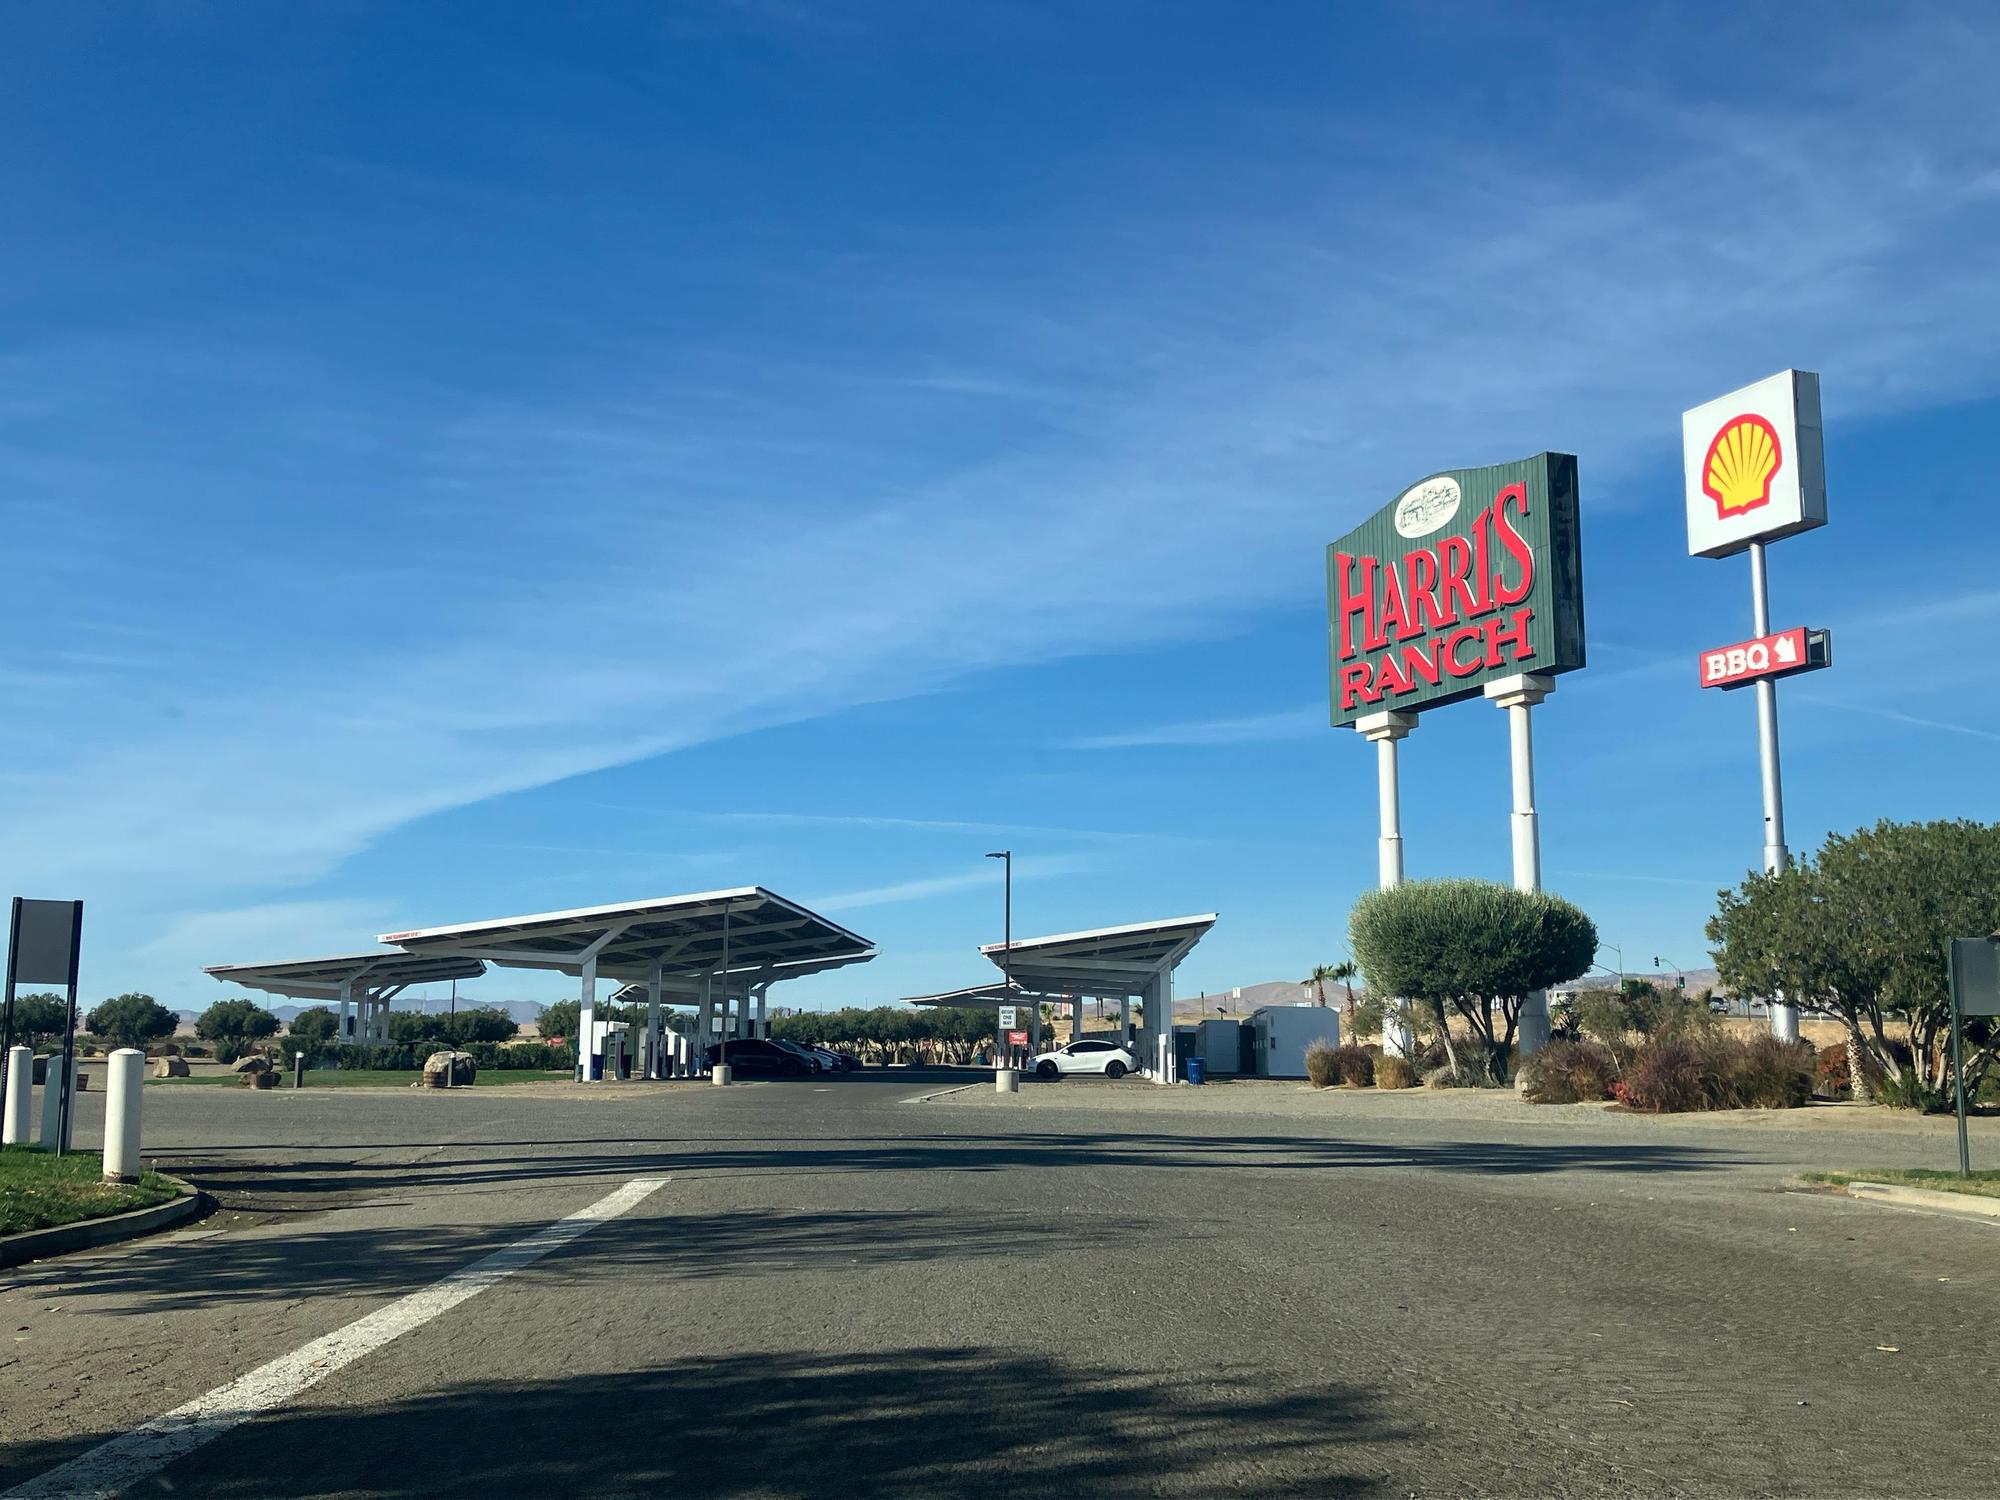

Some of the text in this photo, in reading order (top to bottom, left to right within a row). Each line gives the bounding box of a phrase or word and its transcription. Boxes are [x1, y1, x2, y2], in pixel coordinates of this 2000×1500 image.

[1335, 481, 1534, 660] HARRIS
[1339, 607, 1535, 710] RANCH
[1707, 643, 1769, 680] BBQ
